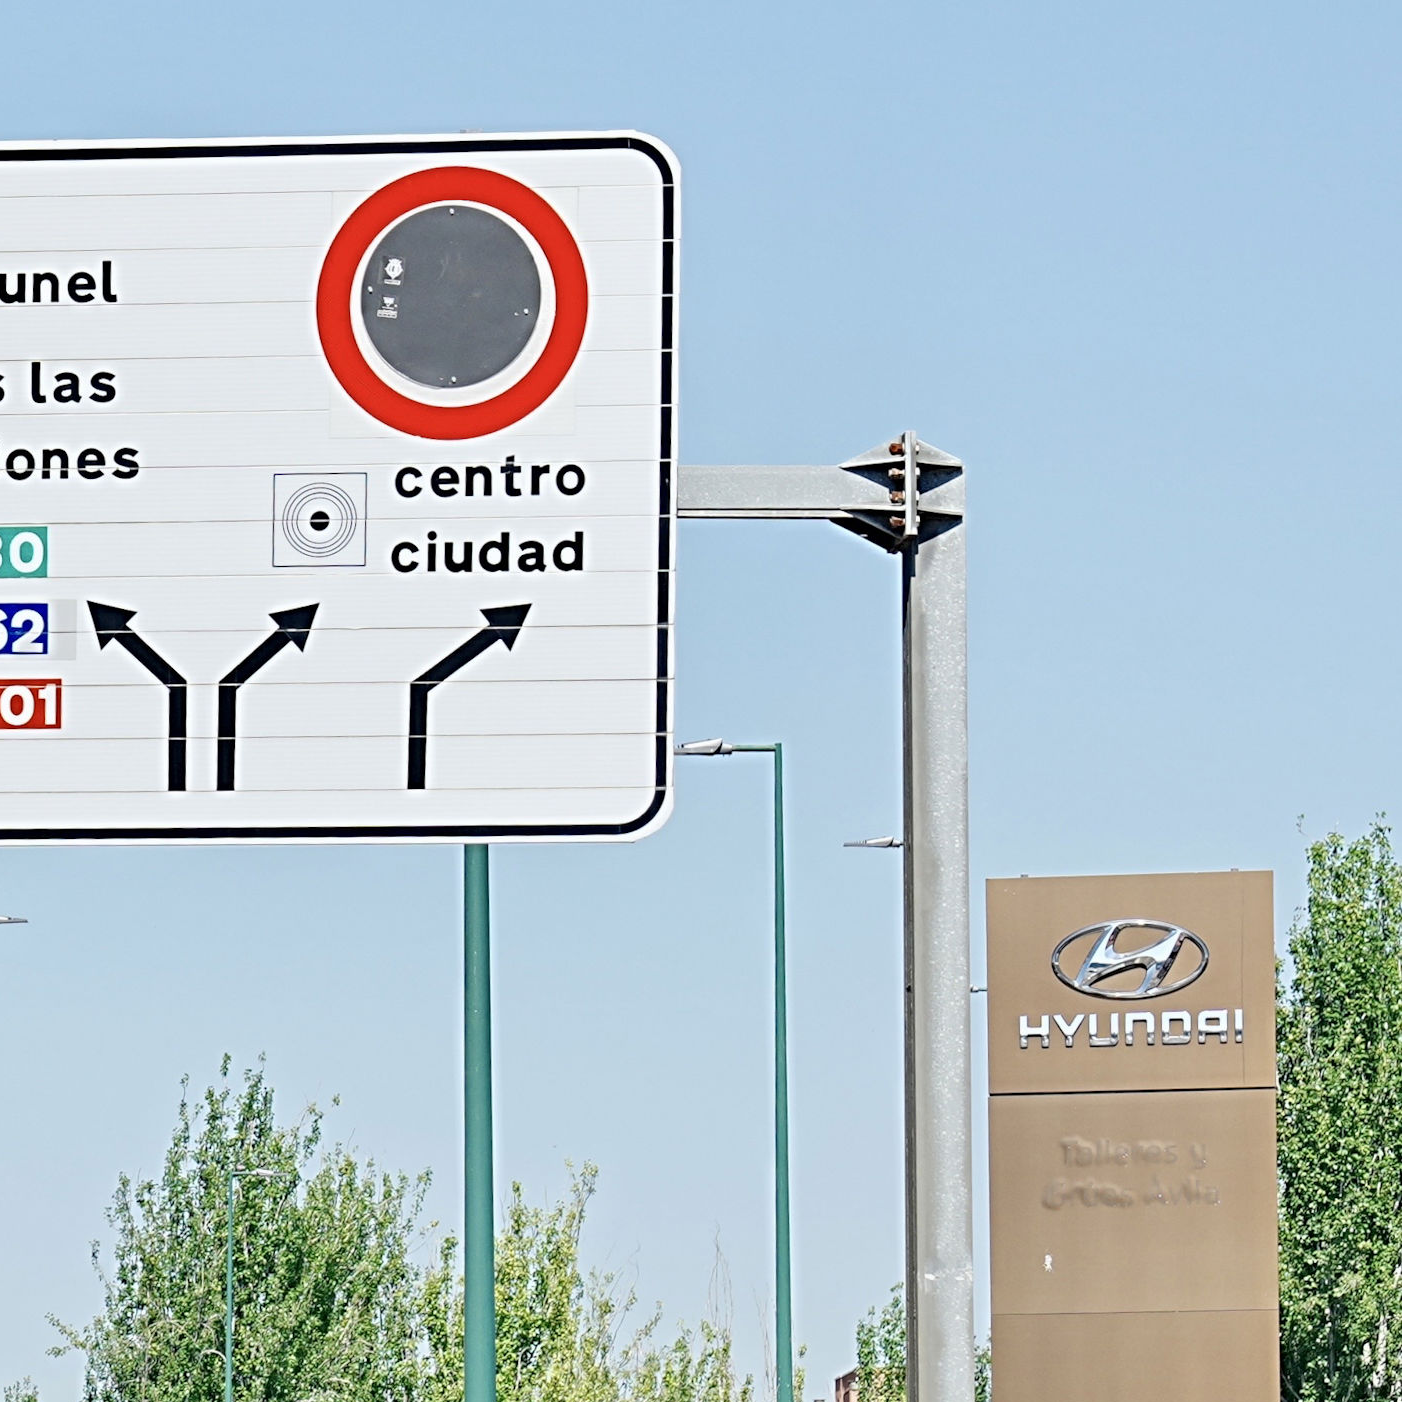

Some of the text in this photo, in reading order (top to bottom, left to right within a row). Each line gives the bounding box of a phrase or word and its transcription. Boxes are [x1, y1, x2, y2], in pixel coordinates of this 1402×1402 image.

[32, 362, 116, 403] las
[396, 456, 585, 497] centro
[391, 531, 583, 573] ciudad
[1018, 1008, 1244, 1048] HYUNDAI
